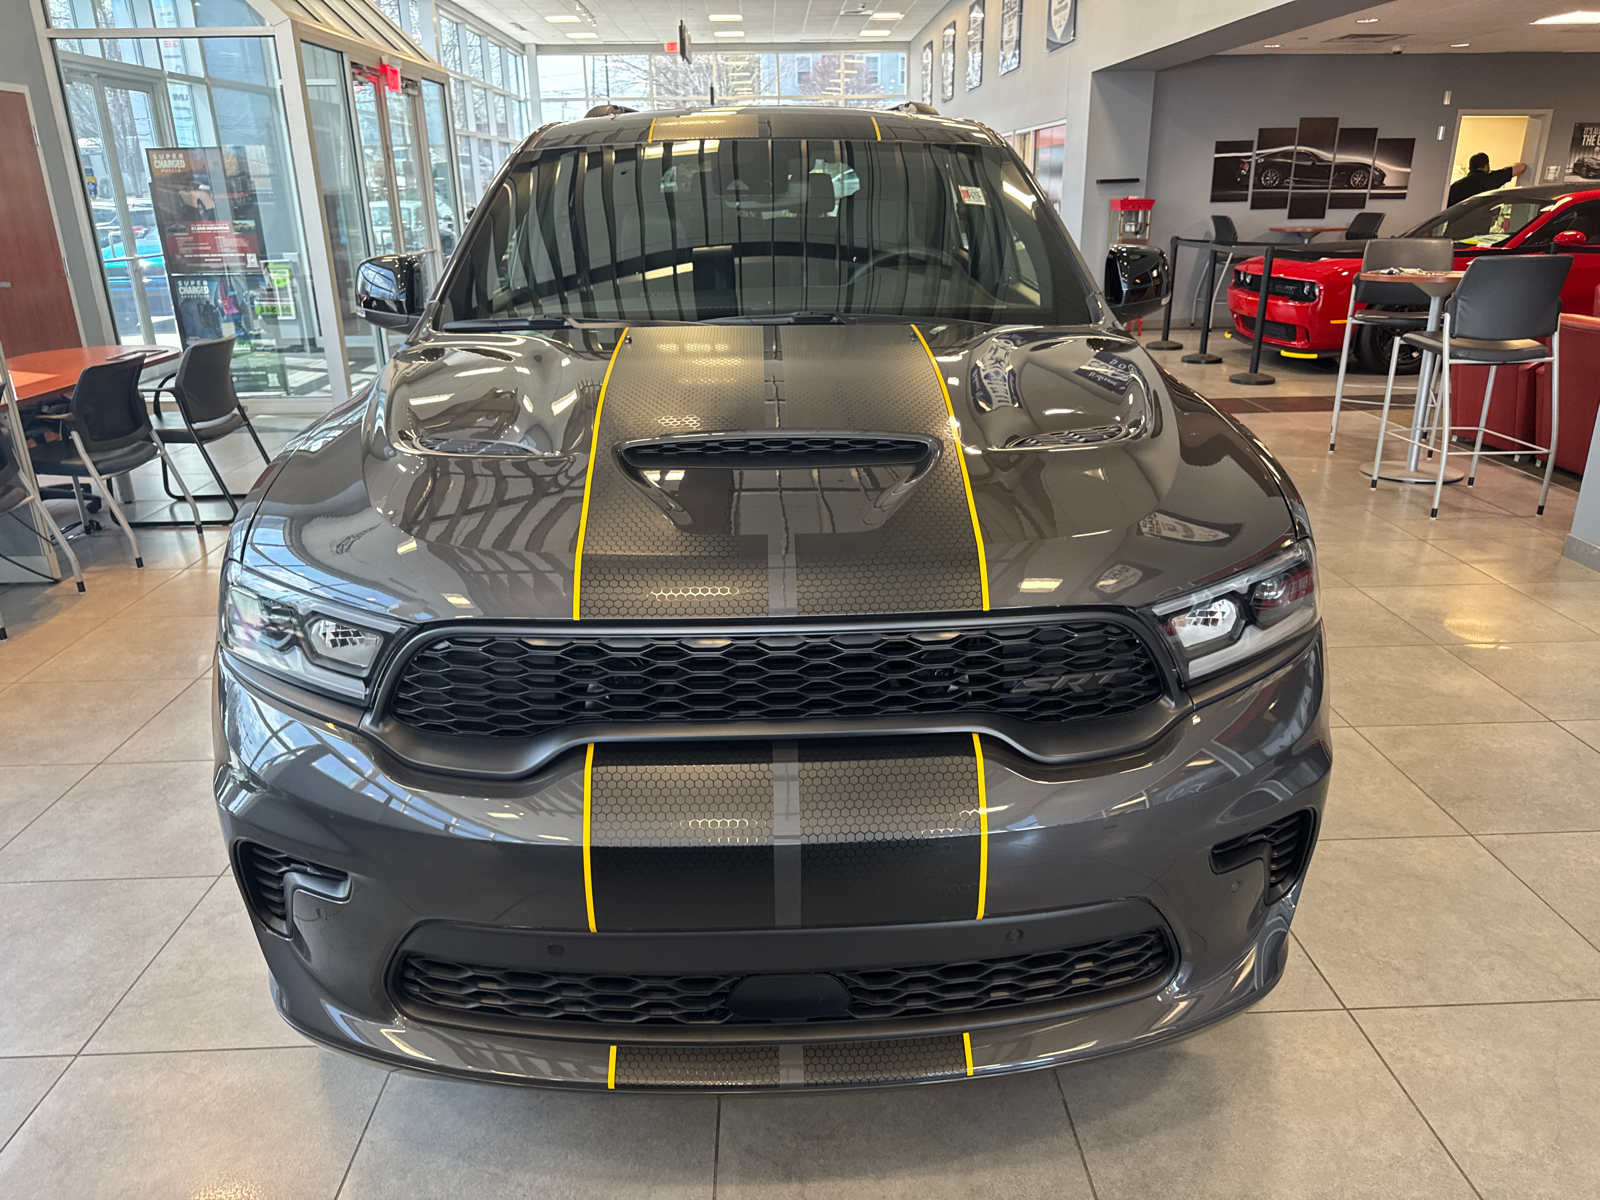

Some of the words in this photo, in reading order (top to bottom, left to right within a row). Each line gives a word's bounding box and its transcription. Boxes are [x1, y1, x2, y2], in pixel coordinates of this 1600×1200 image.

[1582, 134, 1596, 146] THE
[153, 159, 186, 169] CHARGED
[178, 286, 210, 295] CHARGED
[1010, 666, 1130, 694] SRT
